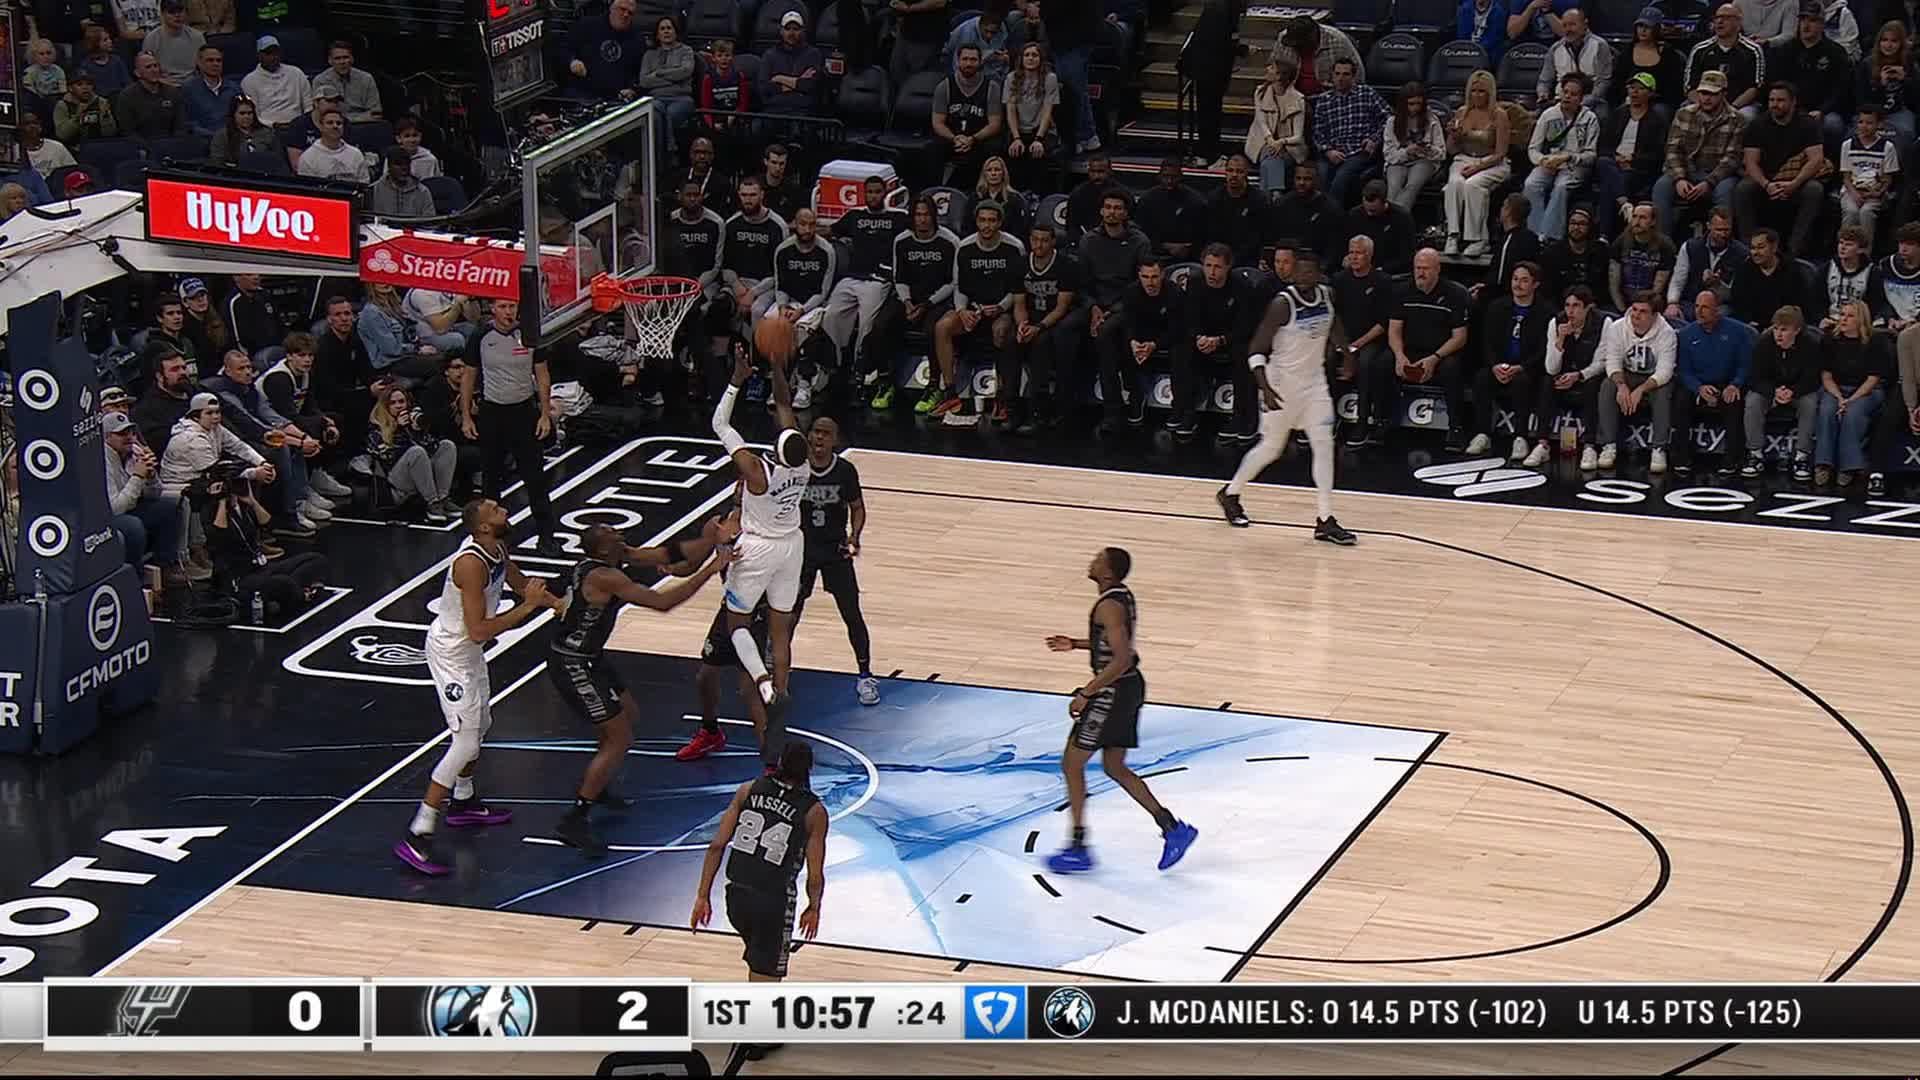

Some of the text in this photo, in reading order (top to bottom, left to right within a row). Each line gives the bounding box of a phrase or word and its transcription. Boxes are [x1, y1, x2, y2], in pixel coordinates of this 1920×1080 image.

[505, 19, 544, 49] TISSOT
[839, 185, 859, 206] G
[186, 190, 316, 243] HyVee
[857, 217, 893, 231] SPURS
[679, 232, 709, 244] PURS
[736, 230, 769, 244] SPURS
[787, 259, 820, 272] SPURS
[907, 250, 943, 263] SPURS
[970, 257, 1007, 270] SPURS
[1408, 398, 1434, 425] G
[811, 509, 826, 528] 3
[66, 639, 150, 702] CFMOTO
[750, 795, 798, 822] VASSELL
[732, 809, 793, 866] 24
